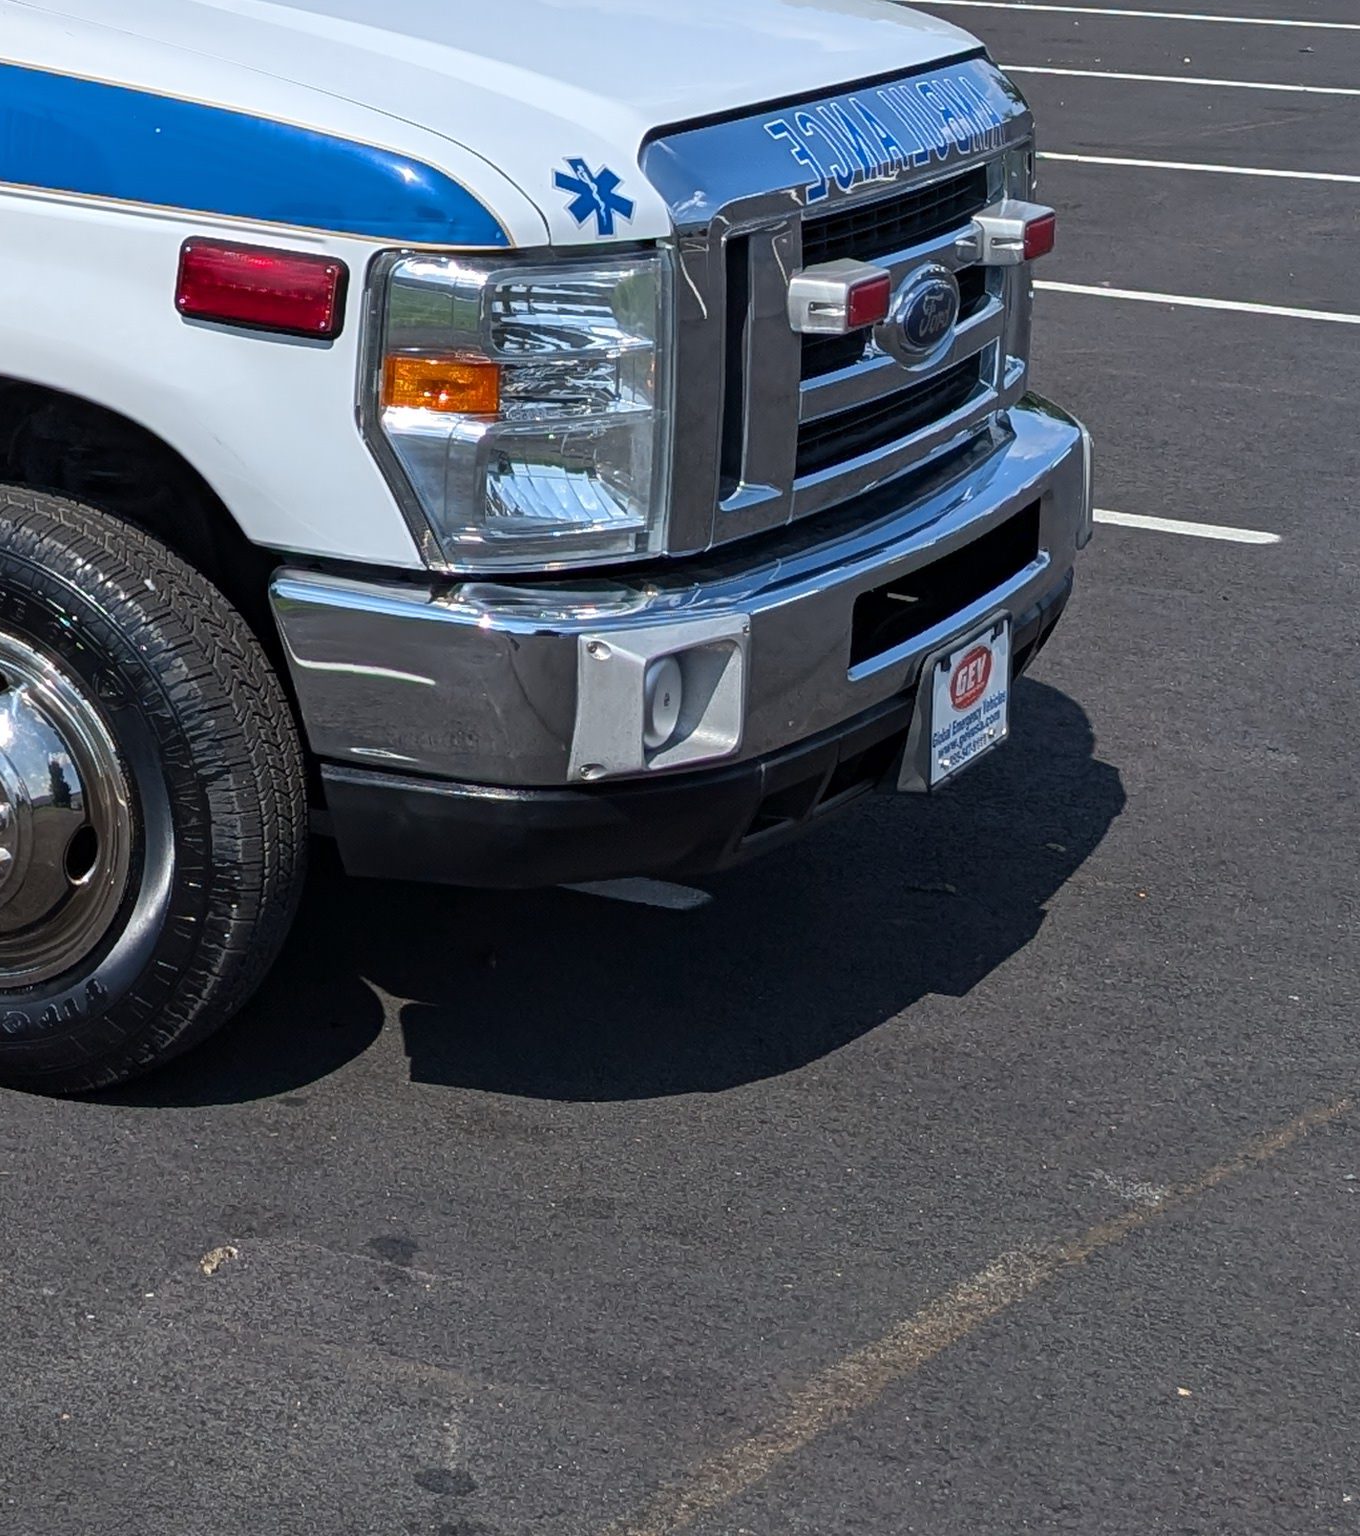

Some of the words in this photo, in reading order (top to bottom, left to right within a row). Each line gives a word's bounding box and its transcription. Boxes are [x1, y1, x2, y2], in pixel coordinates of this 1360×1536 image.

[919, 292, 952, 338] Ford
[955, 652, 987, 697] GEV
[952, 706, 982, 737] Emergency
